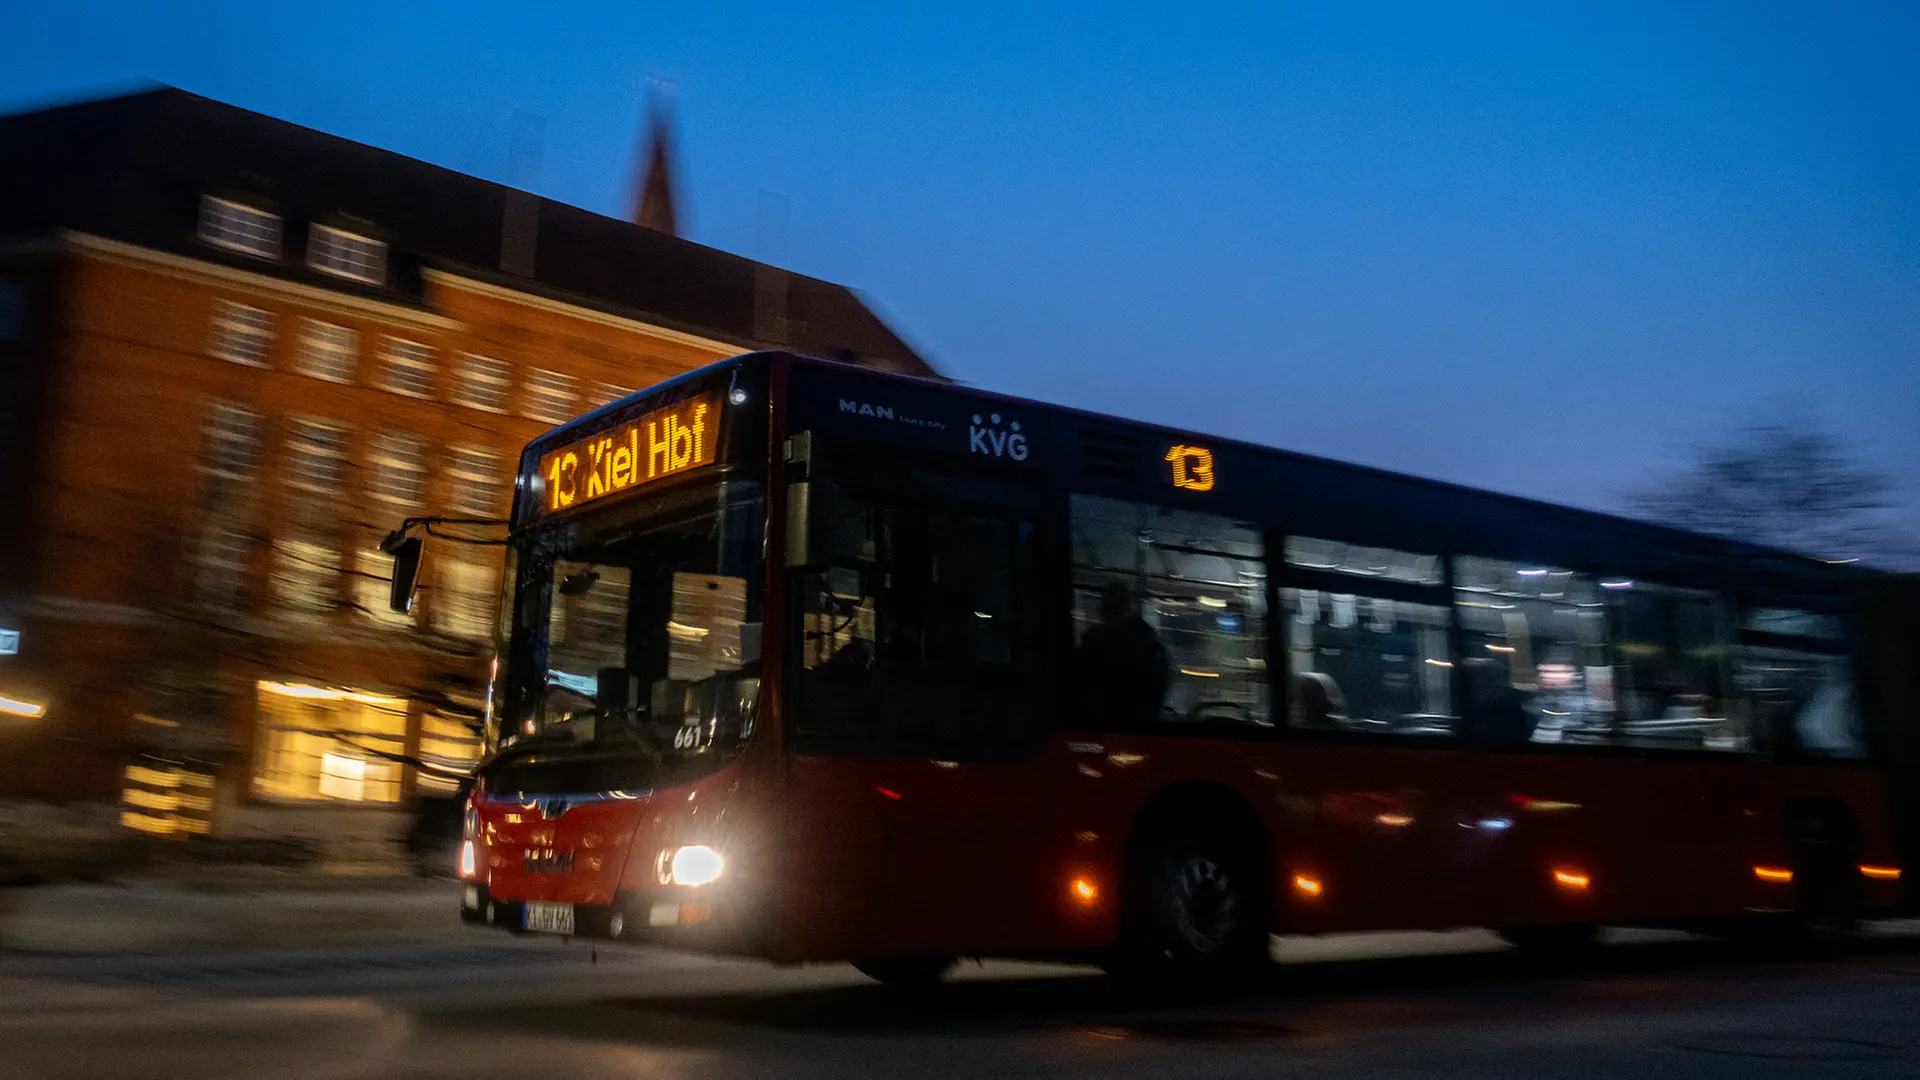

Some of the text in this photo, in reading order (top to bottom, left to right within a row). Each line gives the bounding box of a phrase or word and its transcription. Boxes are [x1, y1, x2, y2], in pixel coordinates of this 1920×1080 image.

[839, 398, 894, 421] MAN
[549, 403, 707, 510] 13 Kiel Hbf
[968, 425, 1029, 462] KVG
[1164, 444, 1214, 491] 13
[674, 725, 701, 749] 661
